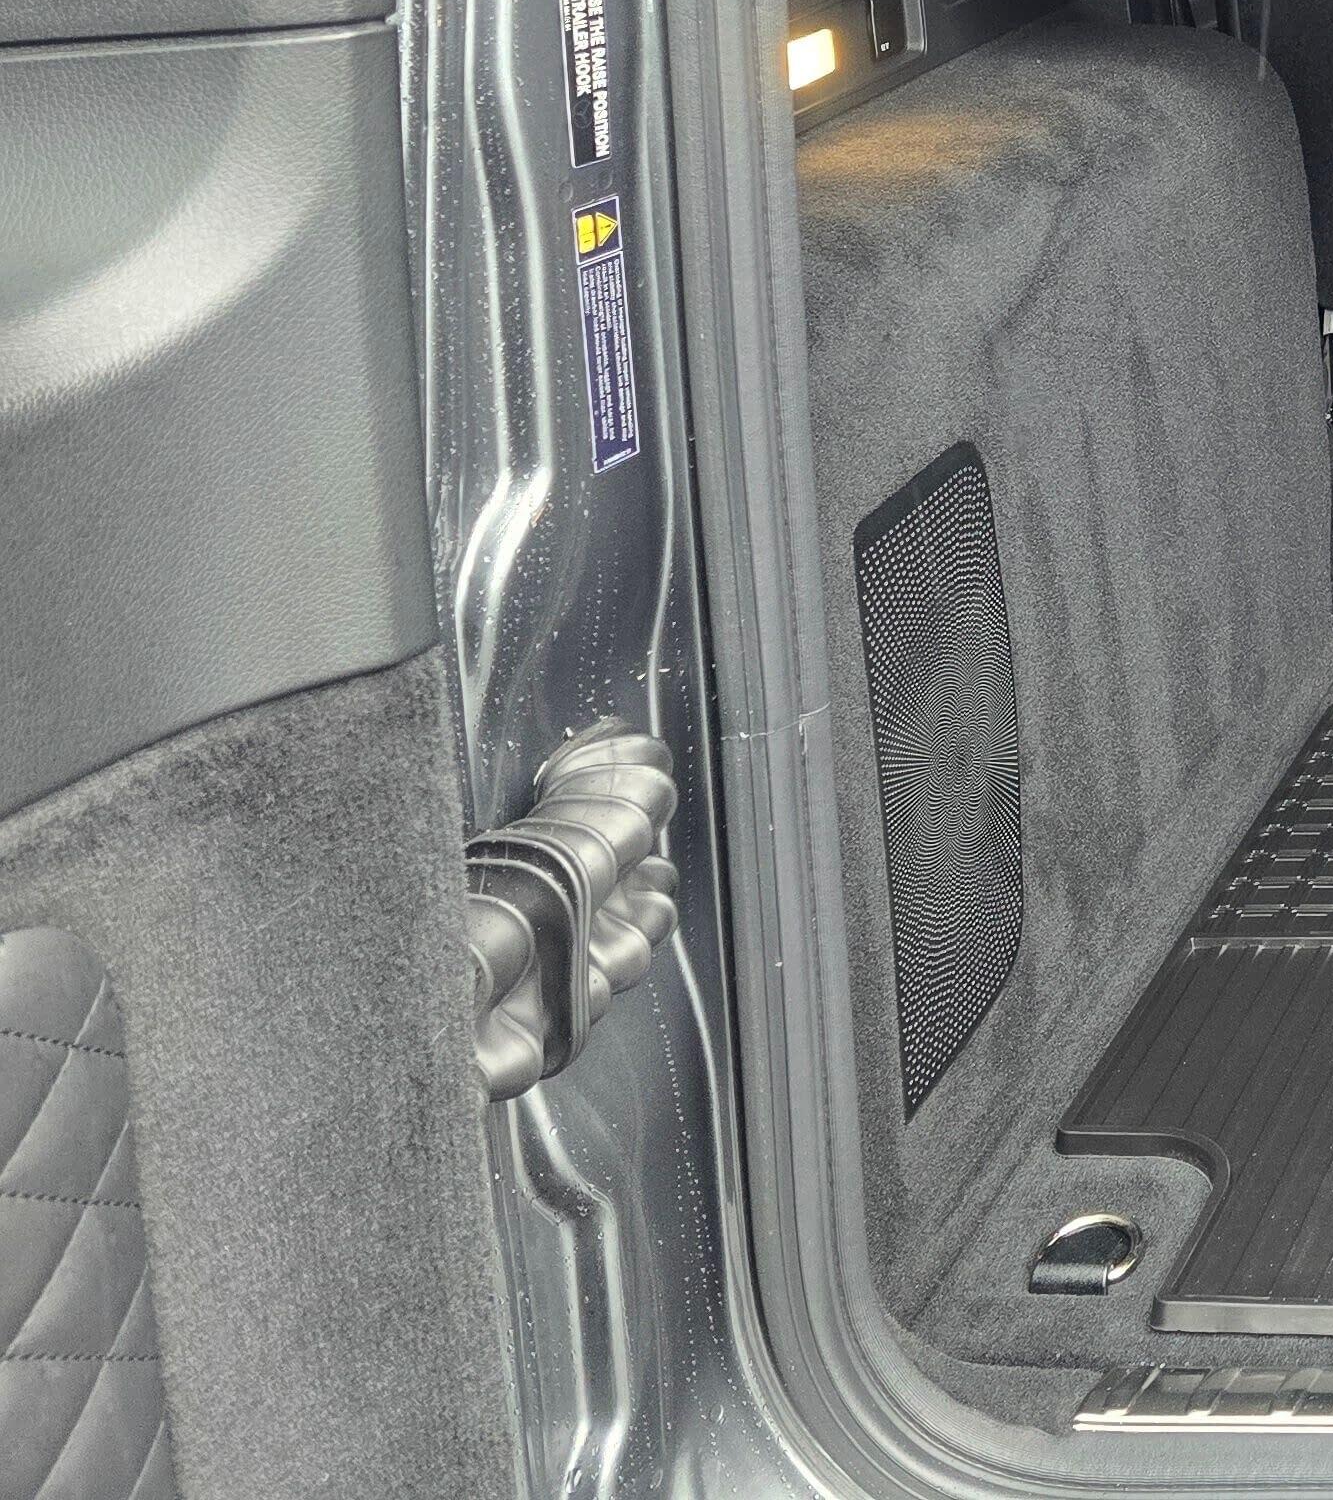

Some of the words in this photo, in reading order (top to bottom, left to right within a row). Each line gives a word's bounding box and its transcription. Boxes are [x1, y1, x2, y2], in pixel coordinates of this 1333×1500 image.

[590, 16, 605, 47] THE
[575, 53, 591, 97] HOOK
[591, 47, 607, 90] RAISE
[593, 90, 609, 157] POSITION
